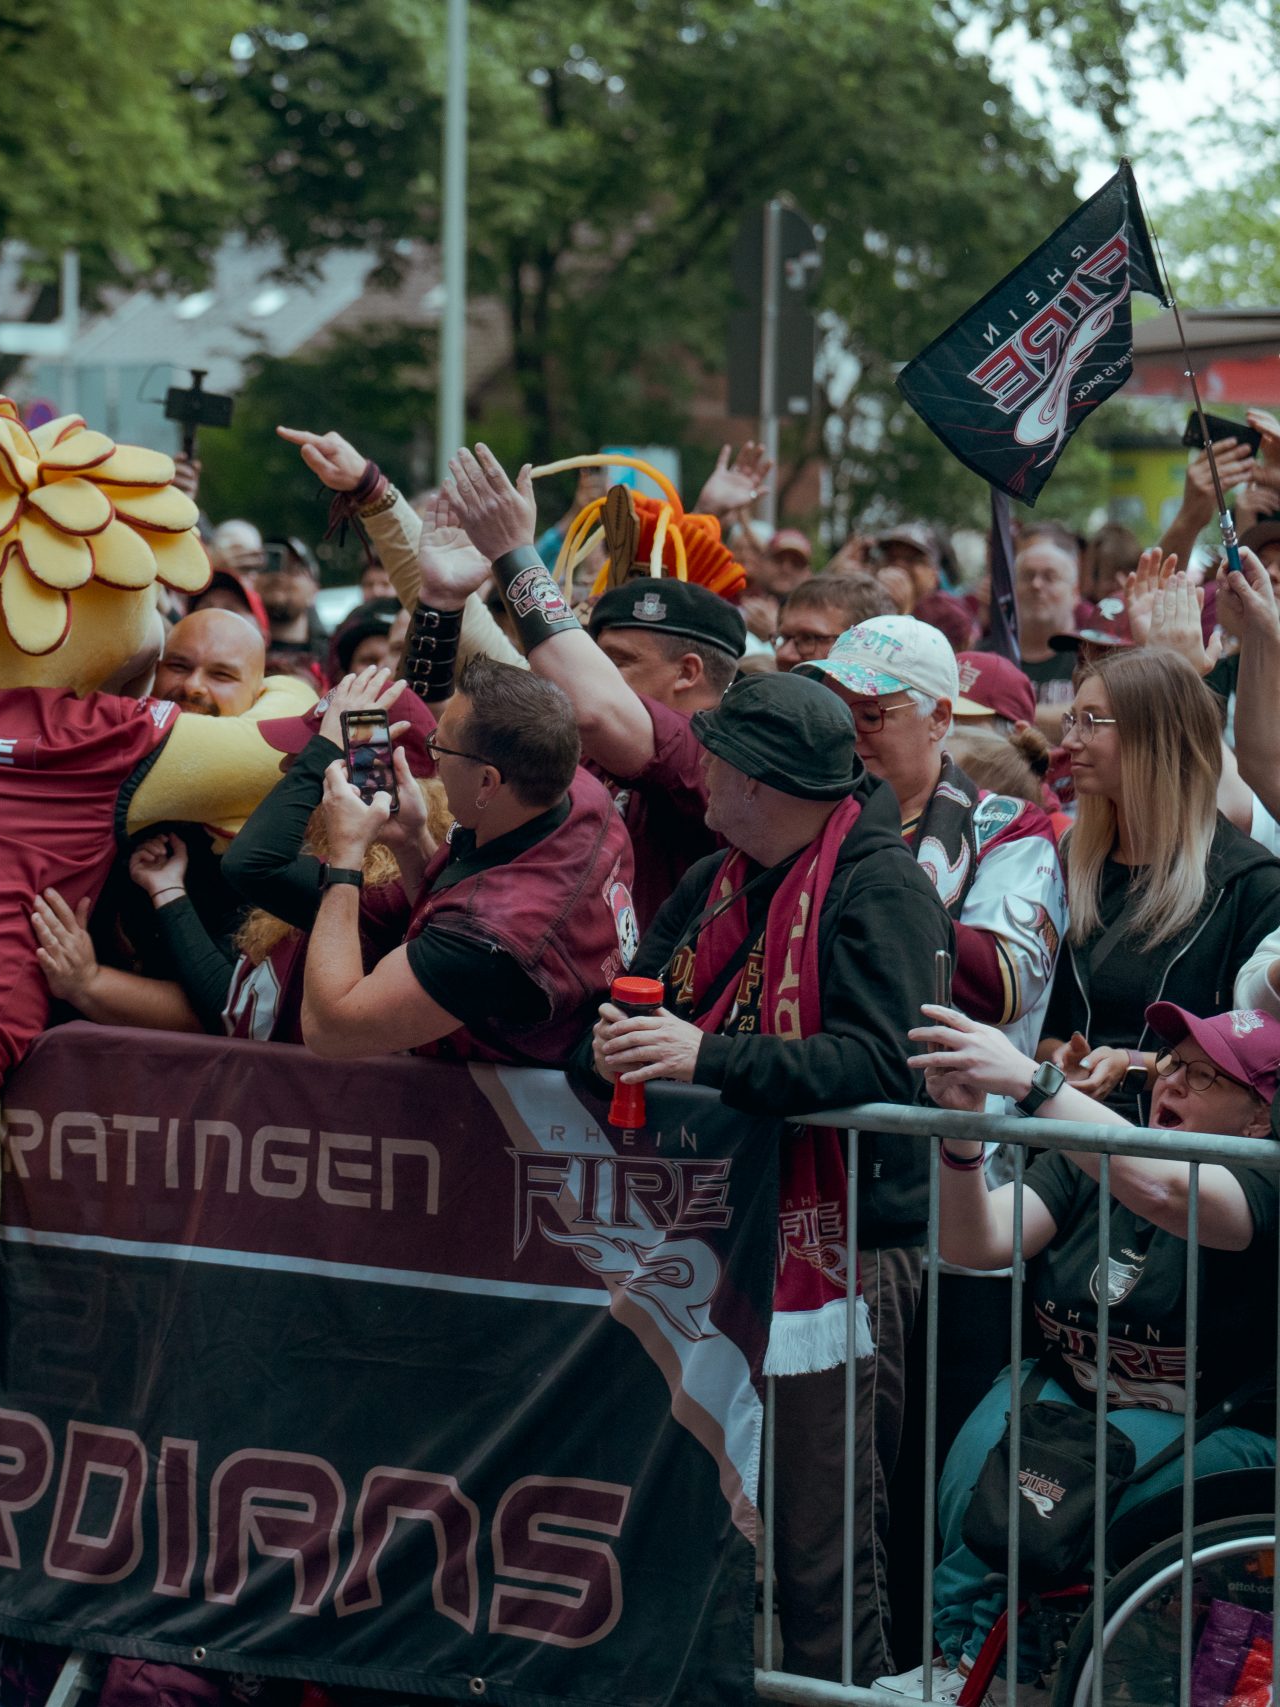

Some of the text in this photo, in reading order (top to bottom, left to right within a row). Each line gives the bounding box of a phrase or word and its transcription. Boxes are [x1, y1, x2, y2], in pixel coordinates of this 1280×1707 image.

[550, 1125, 698, 1152] RHEIN
[2, 1108, 441, 1215] RATINGEN
[504, 1146, 734, 1262] FIRE
[1045, 1300, 1161, 1343] RHIN
[1018, 1470, 1066, 1502] FIRE
